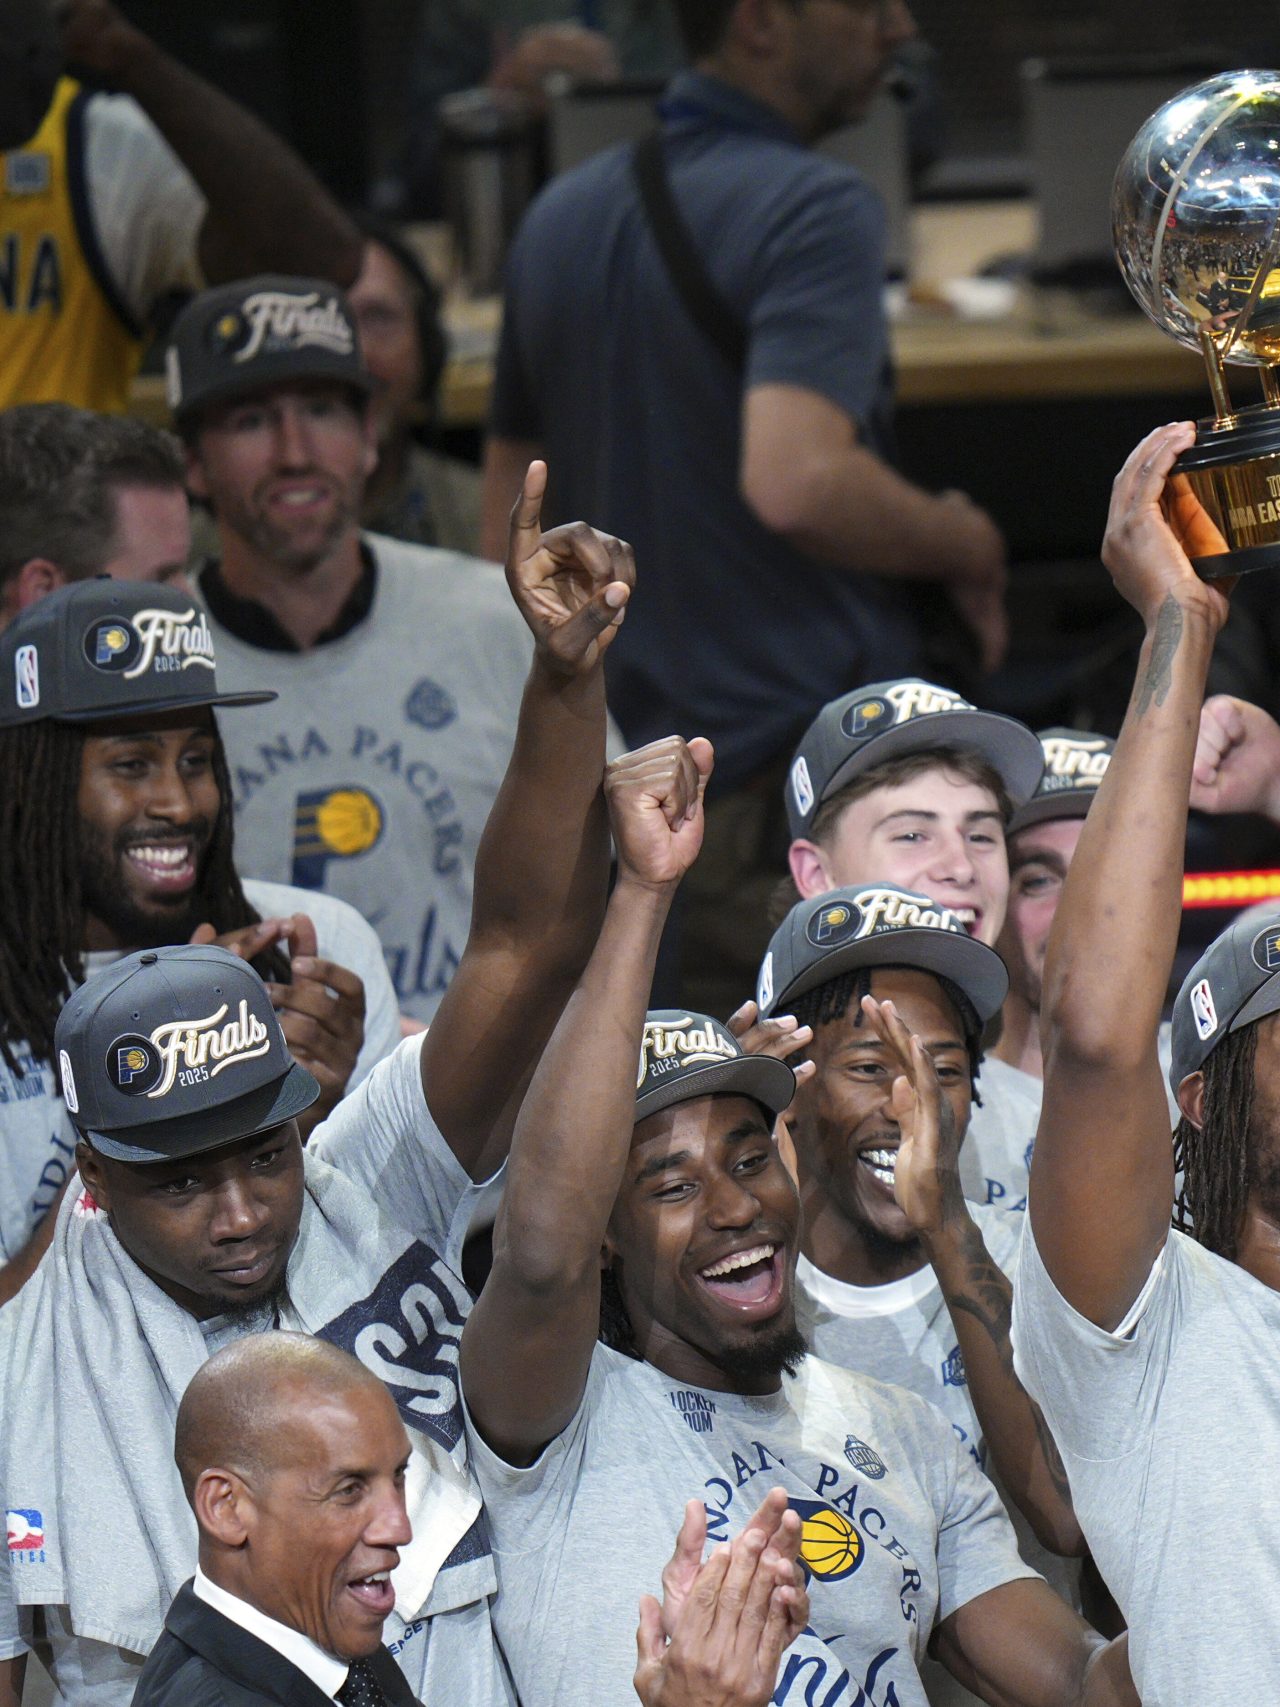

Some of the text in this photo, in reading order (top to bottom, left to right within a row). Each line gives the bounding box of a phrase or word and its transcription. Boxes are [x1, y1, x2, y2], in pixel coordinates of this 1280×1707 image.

[1229, 505, 1257, 529] NBA
[147, 998, 271, 1098] Finals
[178, 1065, 210, 1087] 2025
[649, 1057, 681, 1077] 2025
[683, 1412, 713, 1433] OOM
[813, 1462, 924, 1624] PACERS
